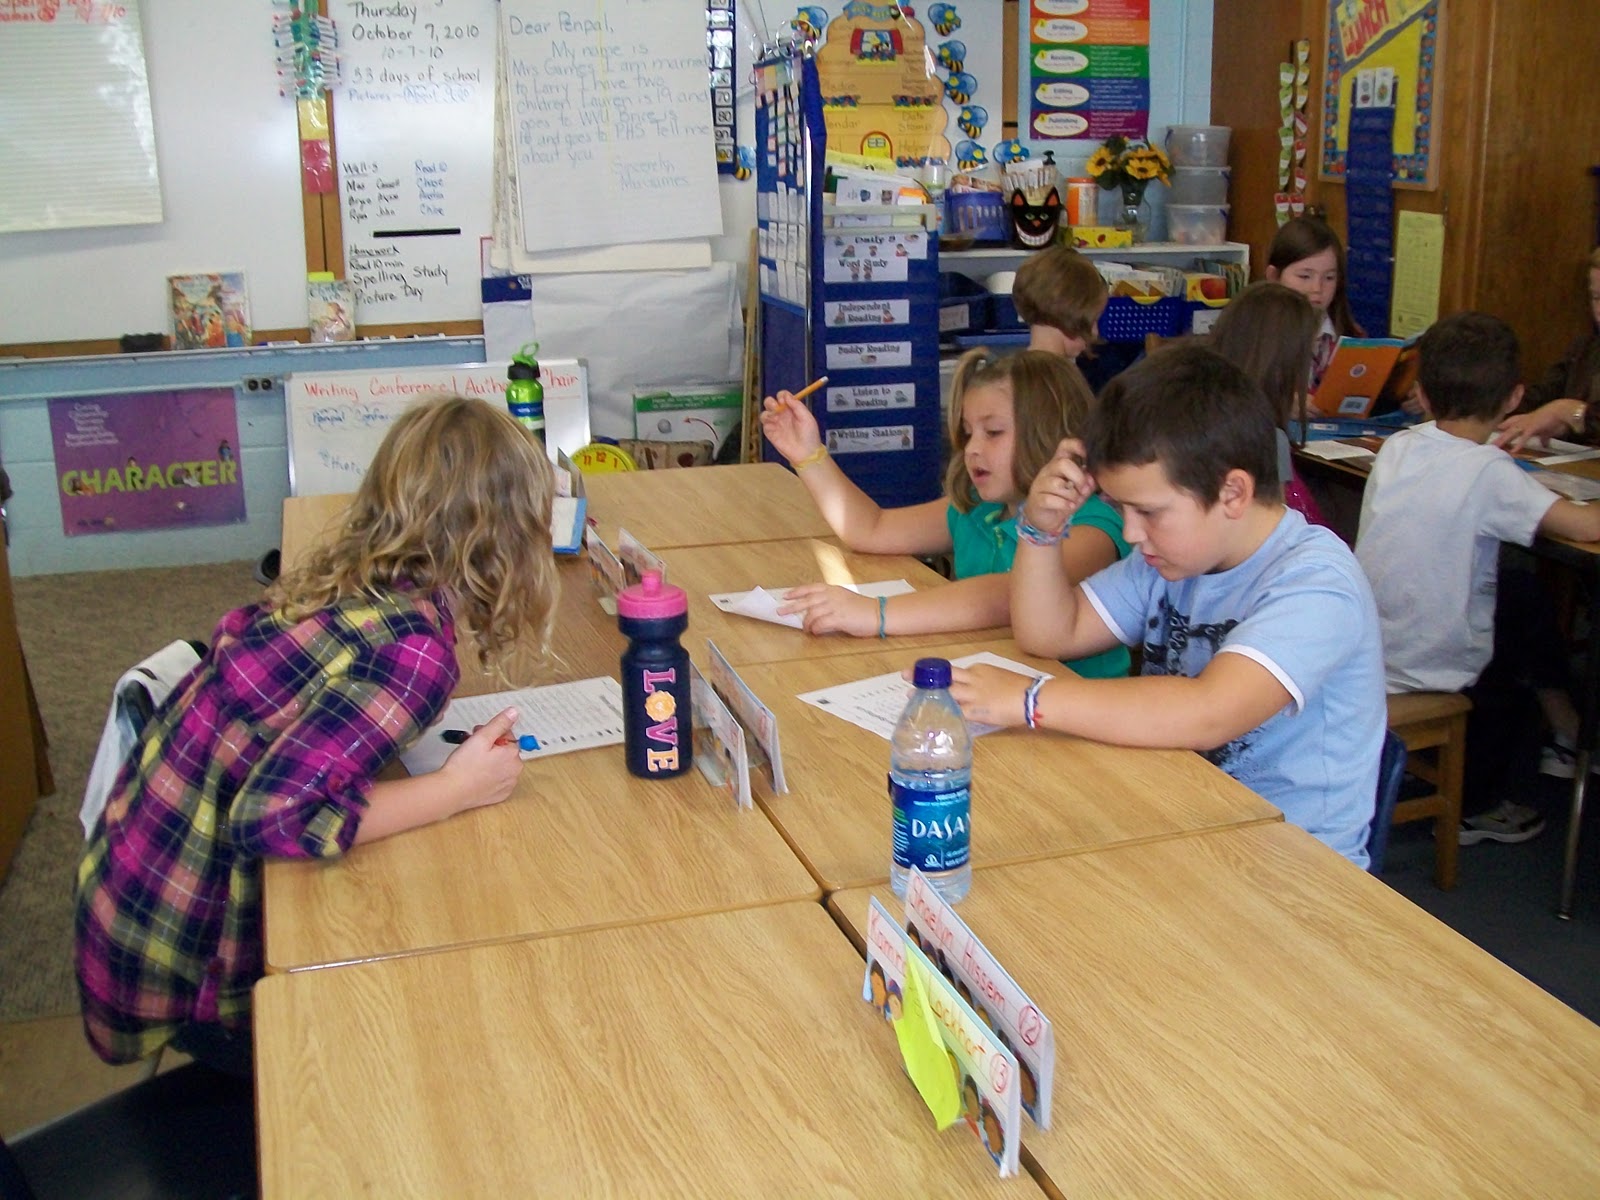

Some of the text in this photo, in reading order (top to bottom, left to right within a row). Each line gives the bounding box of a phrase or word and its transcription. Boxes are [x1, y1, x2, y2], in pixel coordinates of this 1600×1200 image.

[355, 2, 417, 24] Thursday
[352, 23, 412, 41] October
[444, 24, 480, 40] 2010
[509, 15, 549, 35] Dear
[551, 40, 649, 64] My name is
[380, 66, 410, 86] days
[418, 64, 433, 81] of
[442, 66, 480, 82] school
[621, 60, 647, 73] am
[515, 79, 528, 96] to
[634, 72, 665, 89] two
[678, 89, 708, 104] and
[718, 110, 732, 124] 80
[537, 130, 560, 147] and
[653, 118, 680, 137] Tell
[353, 263, 448, 290] Spelling Study
[354, 287, 397, 309] Picture
[400, 283, 424, 303] Day
[838, 302, 891, 313] Independent
[848, 314, 882, 325] Reading
[838, 343, 901, 355] Buddy Reading
[304, 381, 359, 401] Writing
[464, 375, 509, 397] Autho
[852, 386, 891, 397] Listen to
[855, 398, 889, 409] Reading
[837, 428, 870, 439] Writing
[583, 454, 592, 466] 11
[62, 460, 237, 496] CHARACTER
[912, 811, 971, 842] DASA
